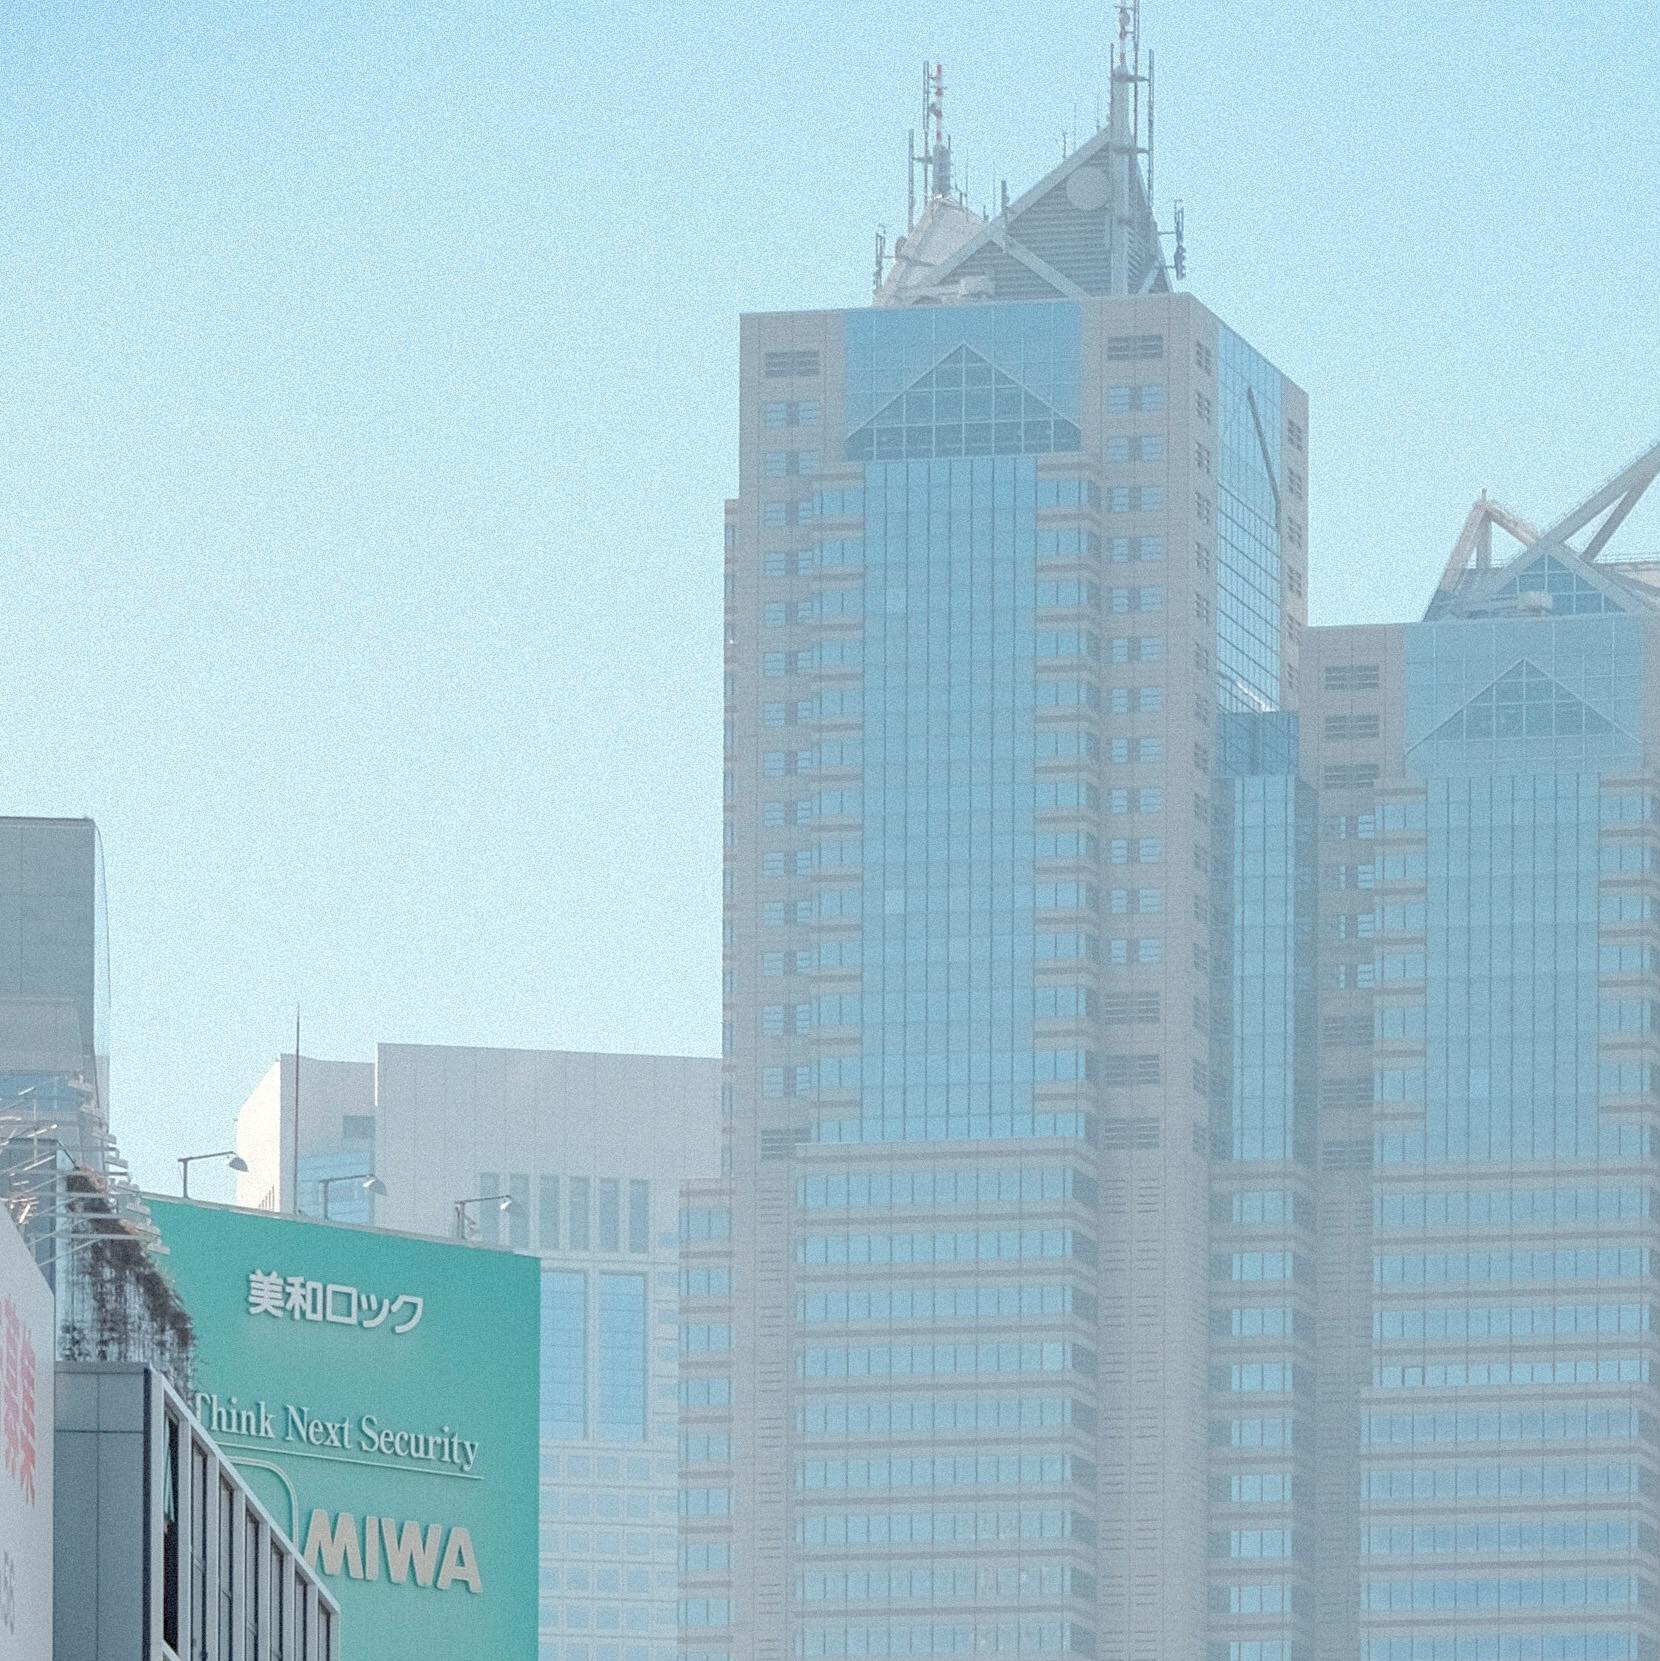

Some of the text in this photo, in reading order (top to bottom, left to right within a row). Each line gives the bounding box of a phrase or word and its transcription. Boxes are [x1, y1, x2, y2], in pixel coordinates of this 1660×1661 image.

[247, 1268, 424, 1334] 美和ロック
[284, 1404, 353, 1451] Next
[360, 1414, 480, 1473] Security
[303, 1508, 483, 1595] MIWA
